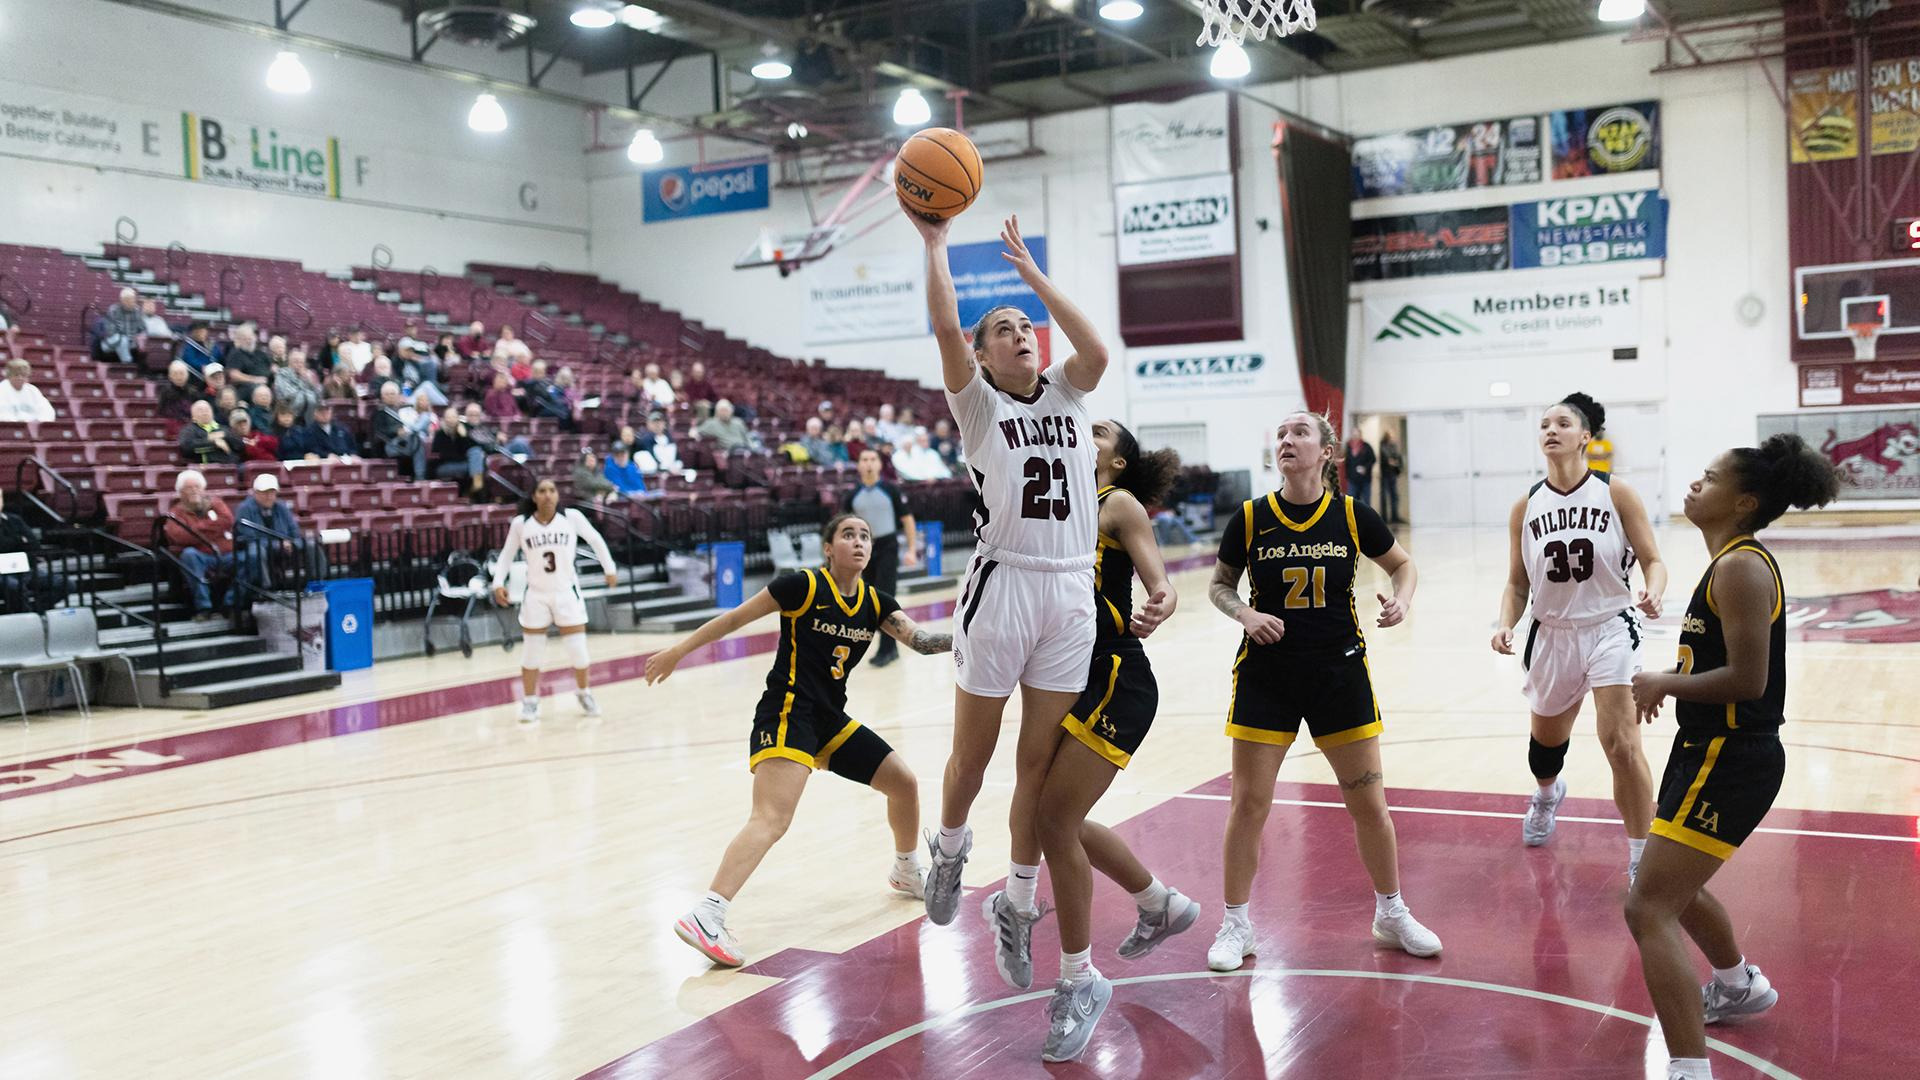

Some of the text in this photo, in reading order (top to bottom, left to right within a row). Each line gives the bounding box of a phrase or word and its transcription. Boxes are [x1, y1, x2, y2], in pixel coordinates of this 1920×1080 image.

[141, 121, 160, 156] E
[252, 127, 325, 176] Line
[356, 156, 369, 187] F
[691, 167, 754, 204] pepsi
[898, 172, 934, 202] NCAA
[519, 183, 537, 211] G
[1537, 192, 1648, 228] KPAY
[1124, 197, 1228, 232] MODERN
[1540, 241, 1646, 266] 93.9 FM
[1473, 287, 1630, 315] Members 1st
[1501, 314, 1602, 334] Credit Union
[1146, 355, 1251, 376] LAMAR
[1021, 456, 1070, 521] 23
[1529, 507, 1610, 541] WILDCATS
[525, 533, 569, 549] WILDCATS
[1257, 541, 1348, 561] Los Angeles
[542, 552, 556, 573] 3
[1544, 538, 1594, 583] 33
[1282, 566, 1326, 609] 21
[812, 618, 874, 642] Los Angeles
[830, 645, 850, 680] 3
[760, 731, 773, 746] LA
[1695, 801, 1719, 833] LA
